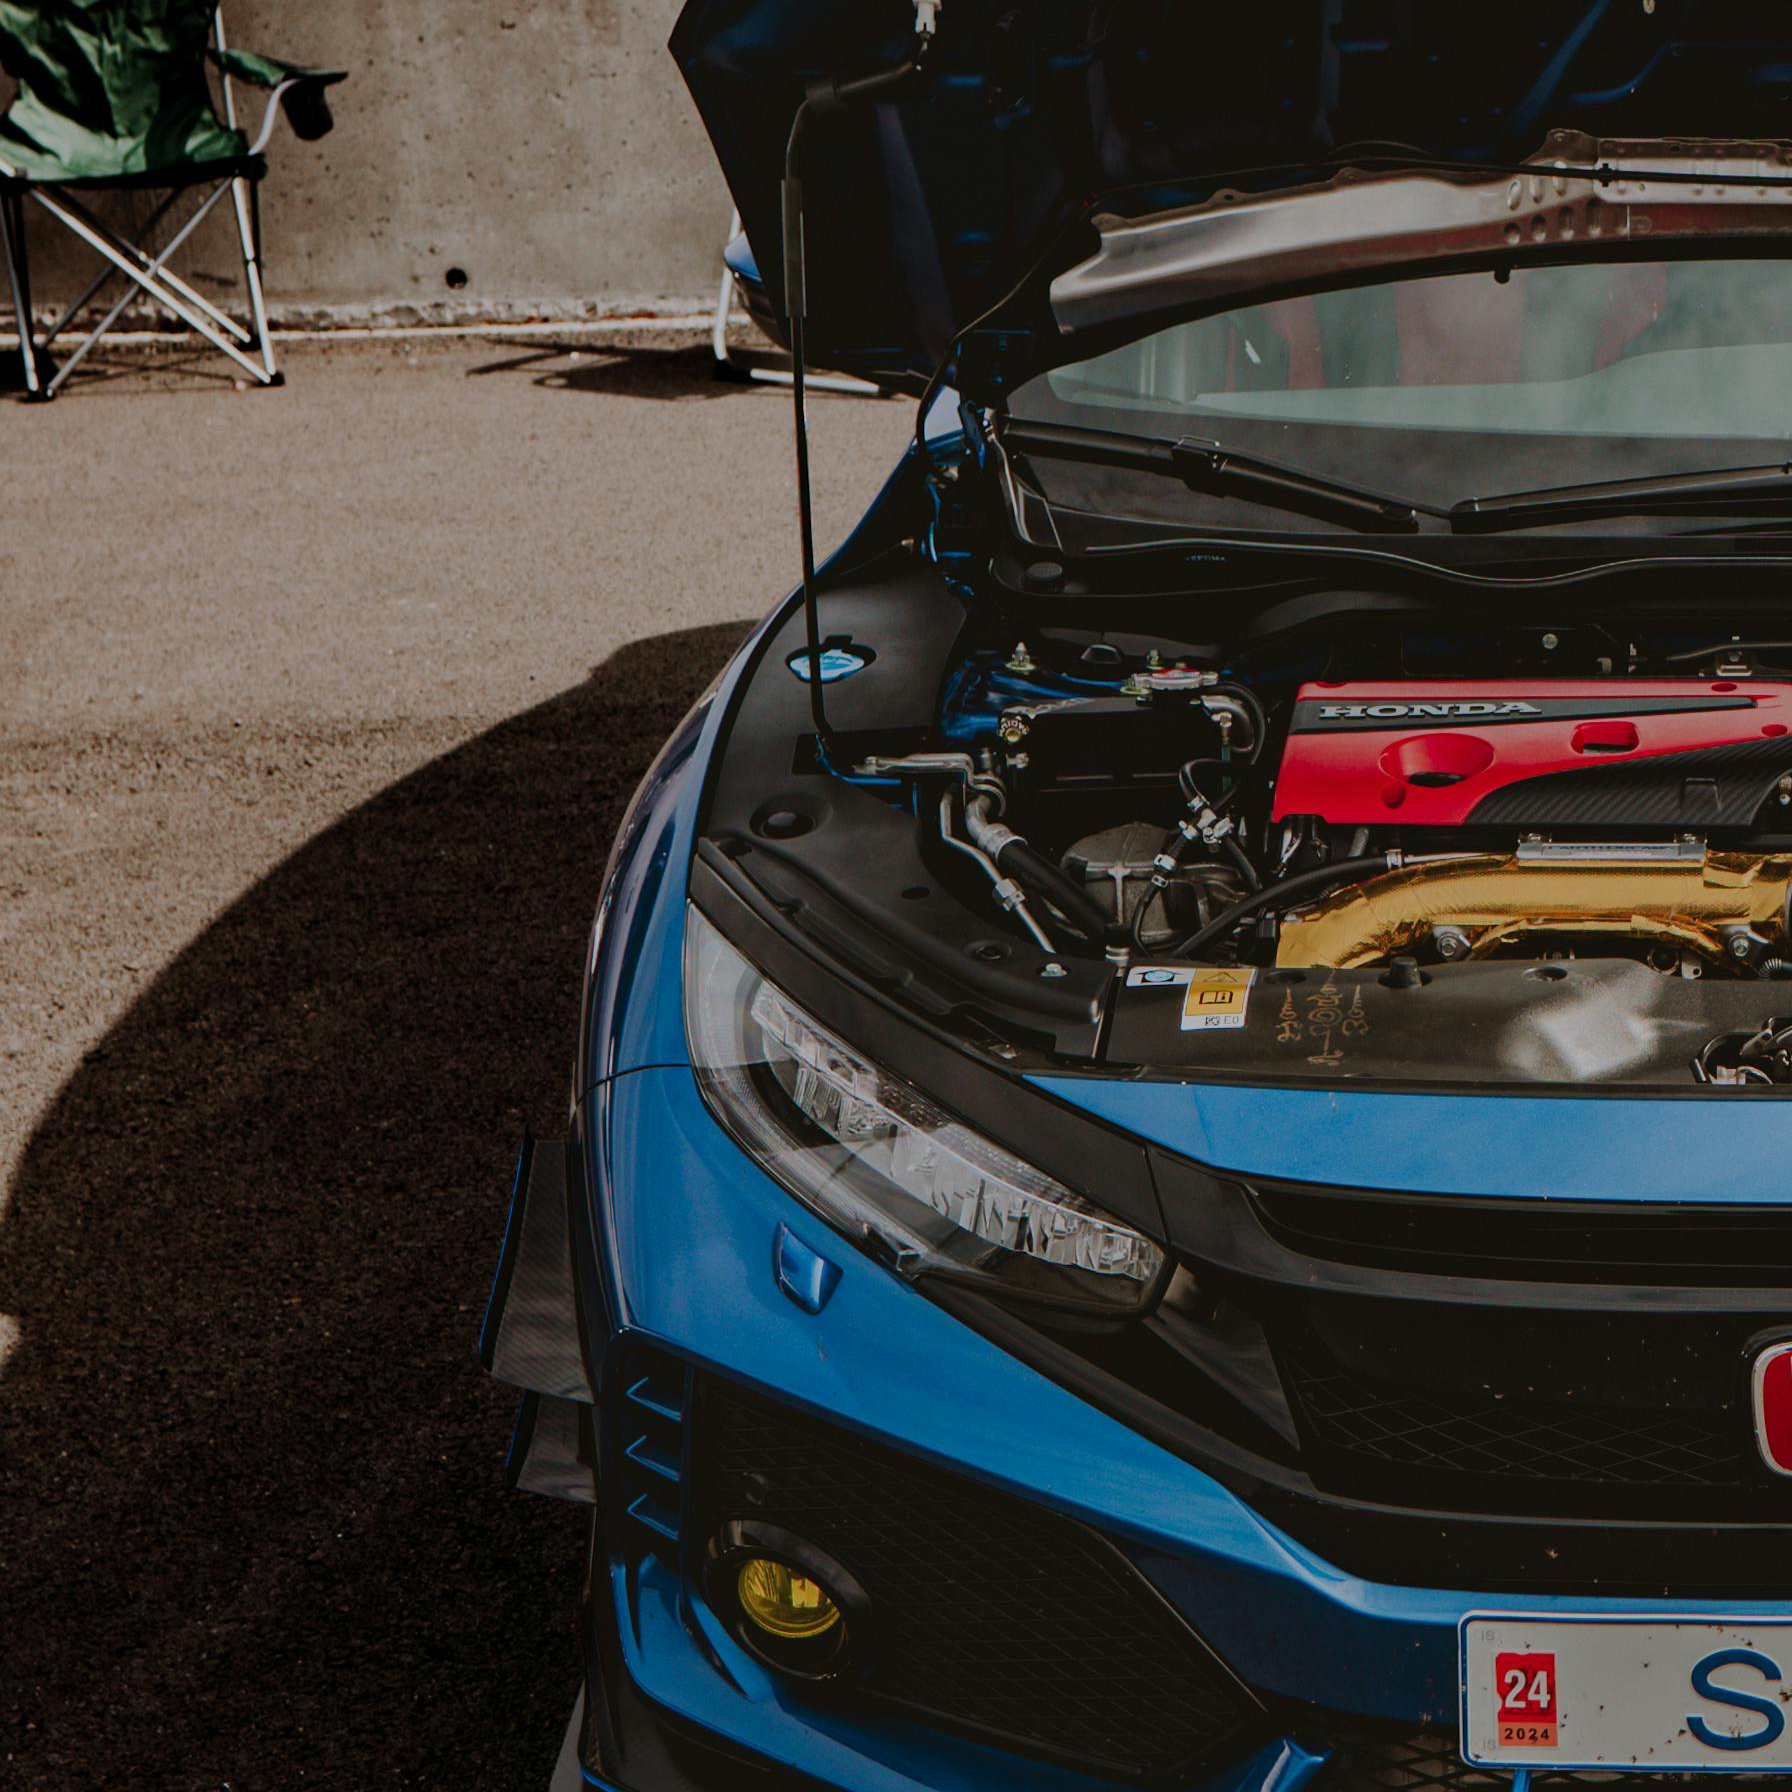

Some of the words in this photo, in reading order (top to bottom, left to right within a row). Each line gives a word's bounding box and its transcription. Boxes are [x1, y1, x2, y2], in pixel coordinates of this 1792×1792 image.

[1319, 701, 1542, 720] HONDA
[1503, 1668, 1552, 1709] 24
[1504, 1727, 1550, 1741] 2024
